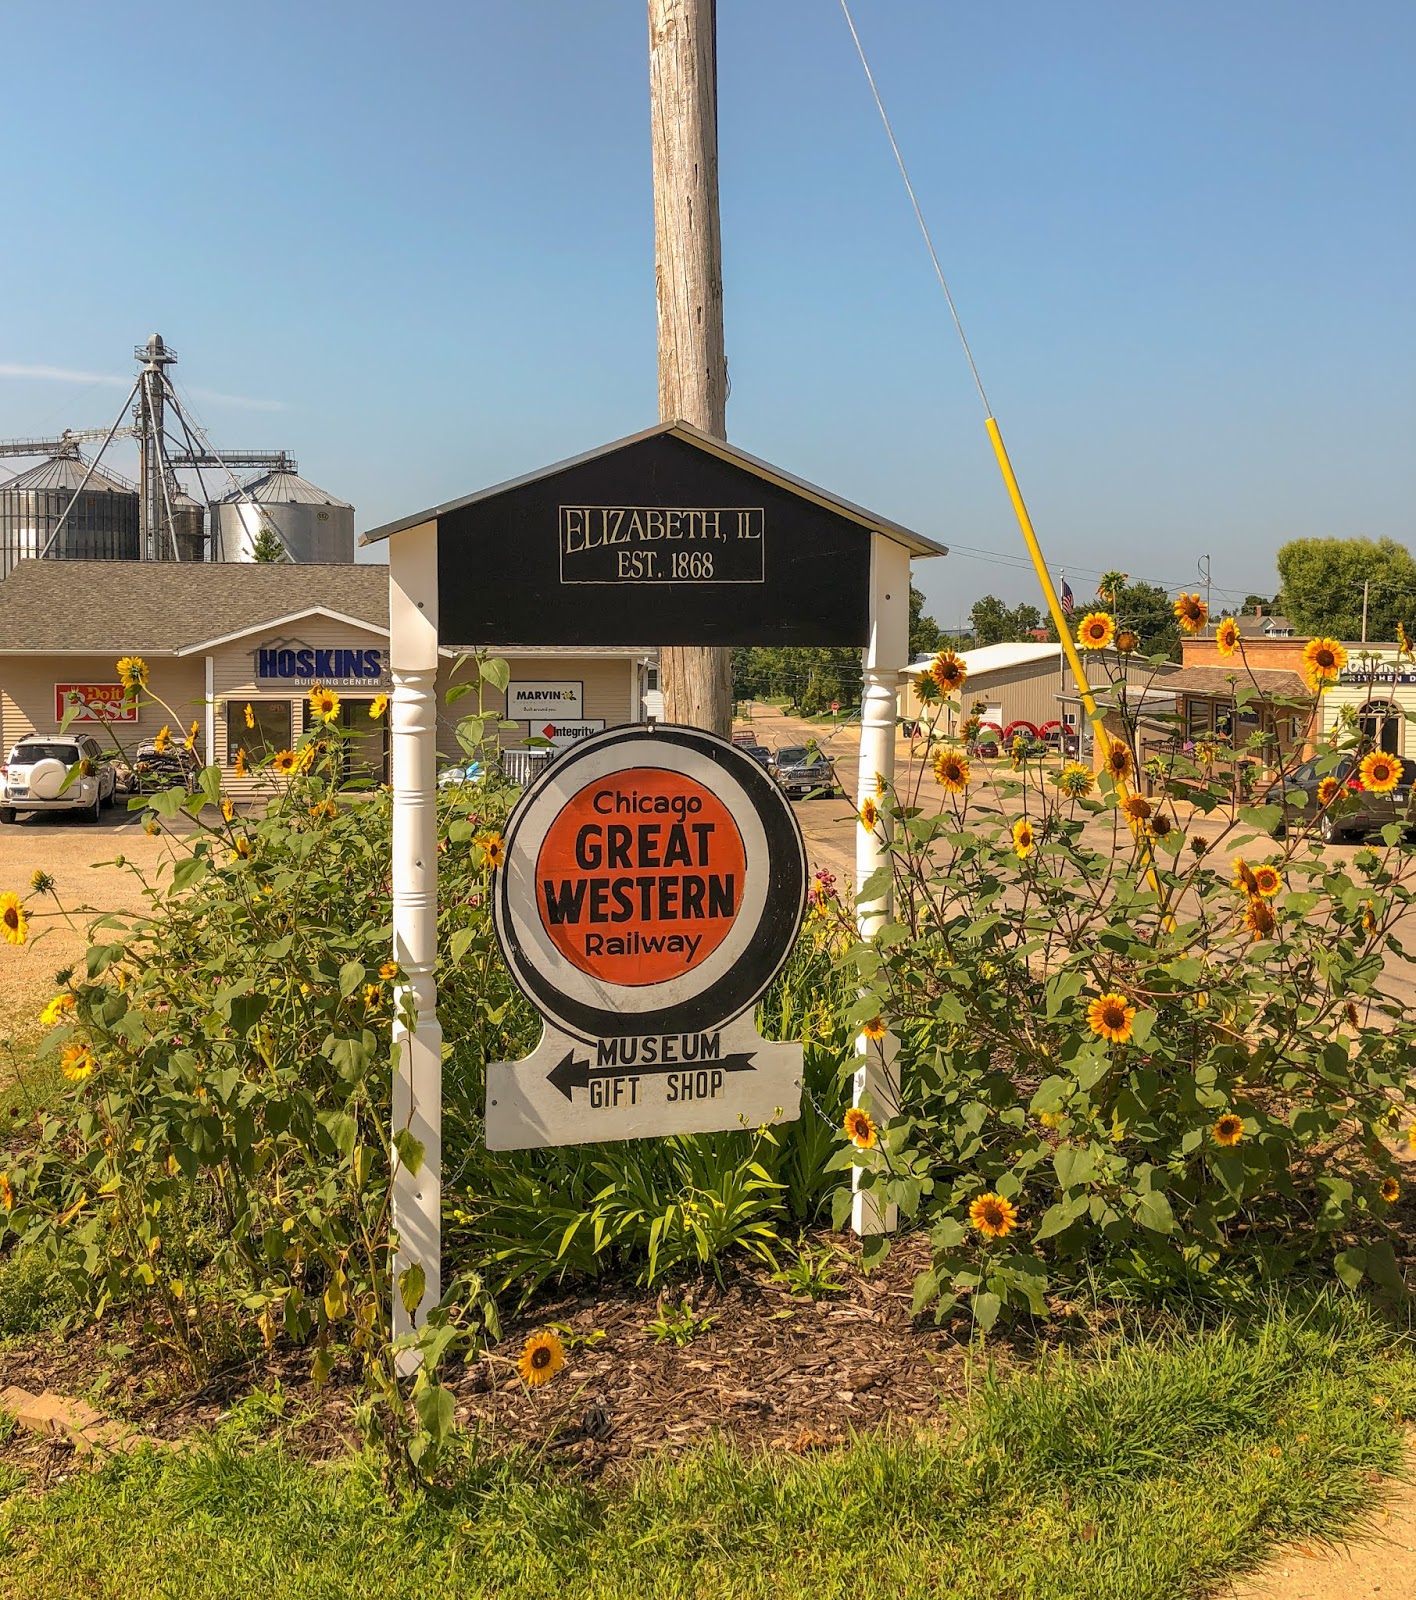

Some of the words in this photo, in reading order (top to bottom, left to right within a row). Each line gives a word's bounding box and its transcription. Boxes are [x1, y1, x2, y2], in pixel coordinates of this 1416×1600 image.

[565, 509, 727, 554] ELIZABETH,
[737, 512, 761, 539] IL
[617, 551, 662, 578] EST.
[671, 551, 714, 579] 1868
[259, 649, 381, 678] HOSKINS
[86, 687, 109, 700] Do
[110, 687, 121, 700] it
[516, 691, 561, 700] MARVIN
[553, 726, 595, 738] Integrity
[592, 790, 703, 823] Chicago
[575, 823, 715, 870] GREAT
[543, 873, 735, 925] WESTERN
[585, 931, 703, 963] Railway
[597, 1032, 720, 1067] MUSEUM
[590, 1077, 640, 1109] GIFT
[666, 1070, 723, 1102] SHOP
